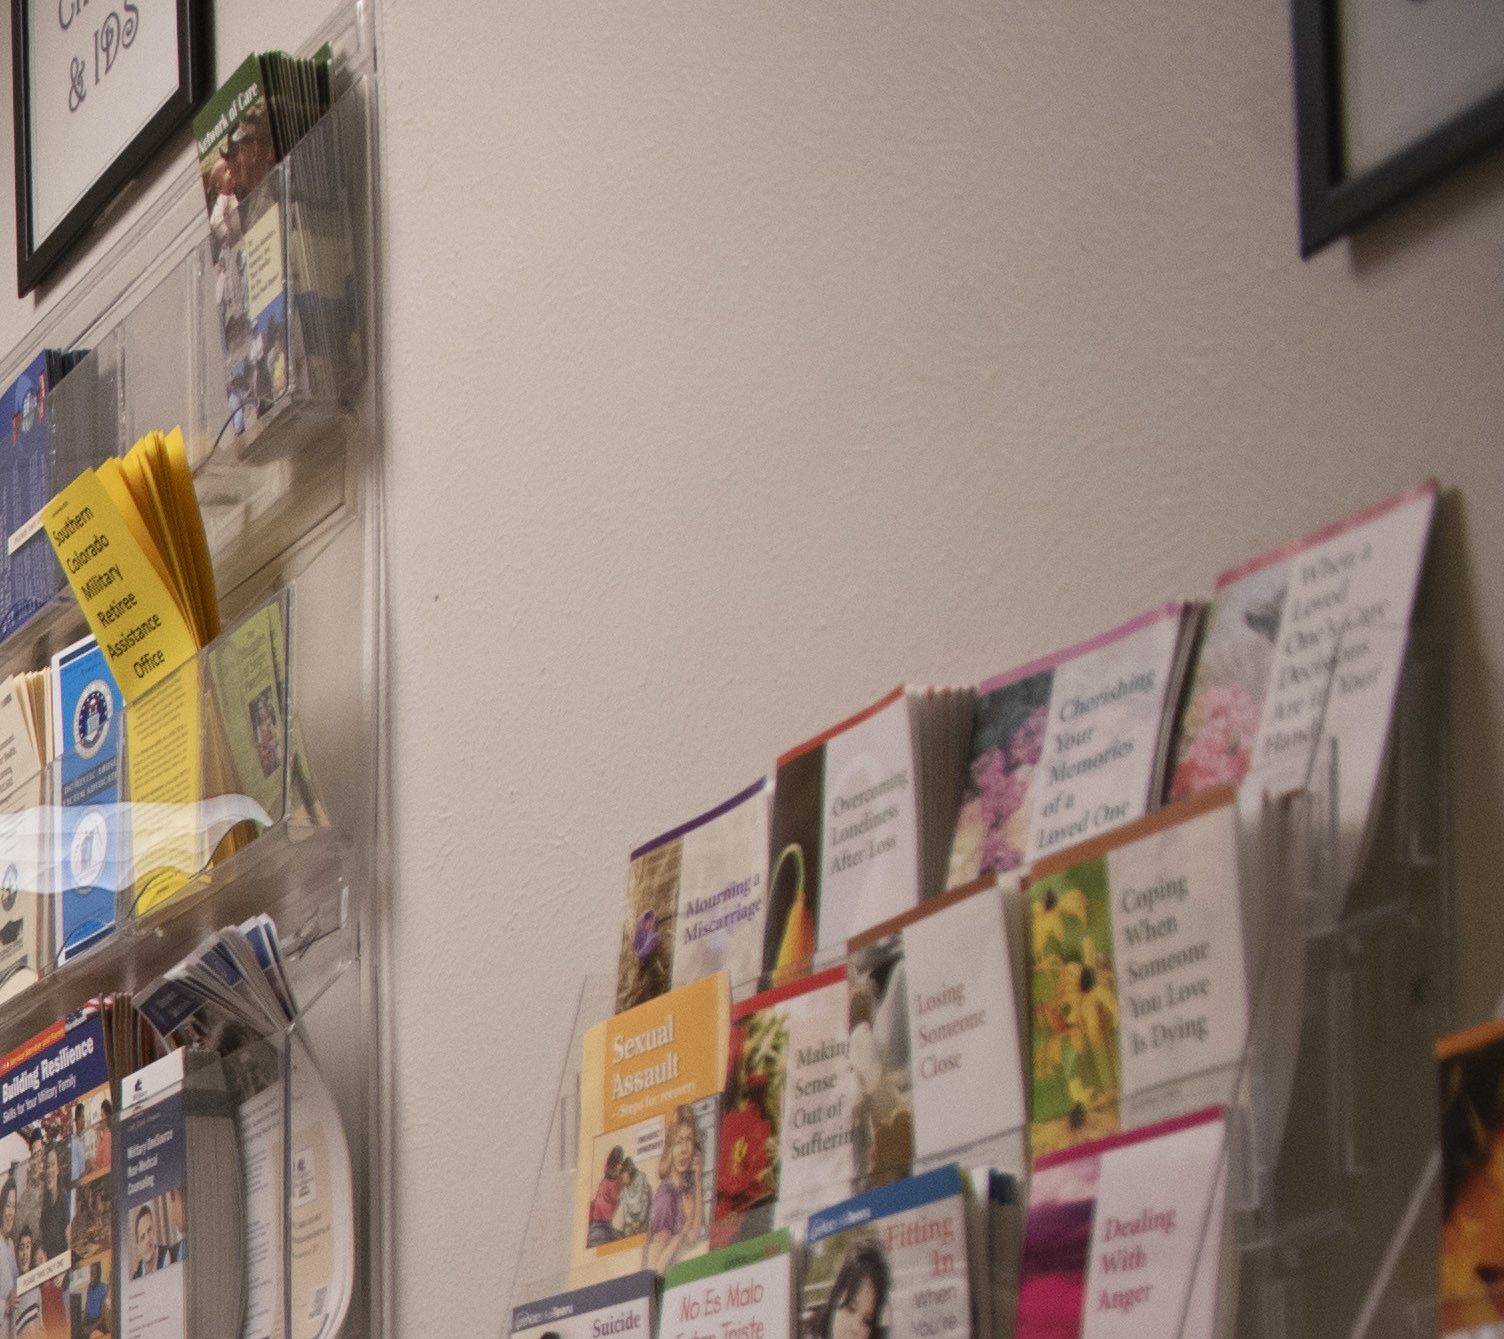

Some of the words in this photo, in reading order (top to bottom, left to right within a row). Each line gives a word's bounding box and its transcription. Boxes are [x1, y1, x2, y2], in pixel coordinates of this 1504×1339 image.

[197, 113, 230, 157] Network
[237, 81, 260, 113] Care
[51, 506, 95, 548] Southern
[65, 533, 110, 576] Colorado
[80, 562, 125, 602] Military
[95, 591, 139, 630] Retiree
[105, 612, 163, 662] Assistance
[132, 648, 167, 680] Office
[1058, 667, 1157, 723] Cherishing
[1054, 725, 1095, 756] Your
[1048, 737, 1136, 788] Memories
[831, 769, 910, 818] Overcoming
[831, 804, 900, 848] Loneliness
[1038, 815, 1089, 850] Loved
[830, 850, 866, 876] After
[867, 834, 897, 861] Loss
[685, 881, 753, 919] Mourning
[1120, 873, 1189, 914] Coping
[683, 898, 763, 945] Miscarriage
[1123, 914, 1178, 948] When
[1126, 938, 1211, 985] Someone
[915, 982, 966, 1016] Losing
[1167, 976, 1211, 1010] Love
[612, 1013, 676, 1065] Sexual
[917, 1008, 987, 1049] Someone
[1151, 1014, 1210, 1052] Dying
[1, 1066, 40, 1104] Building
[40, 1036, 95, 1081] Resilience
[612, 1052, 680, 1100] Assault
[795, 1072, 837, 1098] Sense
[919, 1051, 963, 1082] Close
[2, 1108, 17, 1125] Skills
[17, 1103, 26, 1117] for
[24, 1096, 38, 1112] Your
[38, 1084, 59, 1106] Military
[58, 1074, 77, 1094] Family
[793, 1105, 822, 1130] Out
[824, 1095, 844, 1120] of
[886, 1215, 954, 1253] Fitting
[1103, 1207, 1178, 1243] Dealing
[931, 1251, 955, 1276] In
[1101, 1246, 1147, 1274] With
[679, 1297, 700, 1323] No
[703, 1288, 722, 1315] Es
[726, 1280, 764, 1309] Malo
[913, 1284, 957, 1309] When
[1097, 1282, 1154, 1314] Anger
[591, 1309, 642, 1339] Suicide
[911, 1314, 959, 1339] You're
